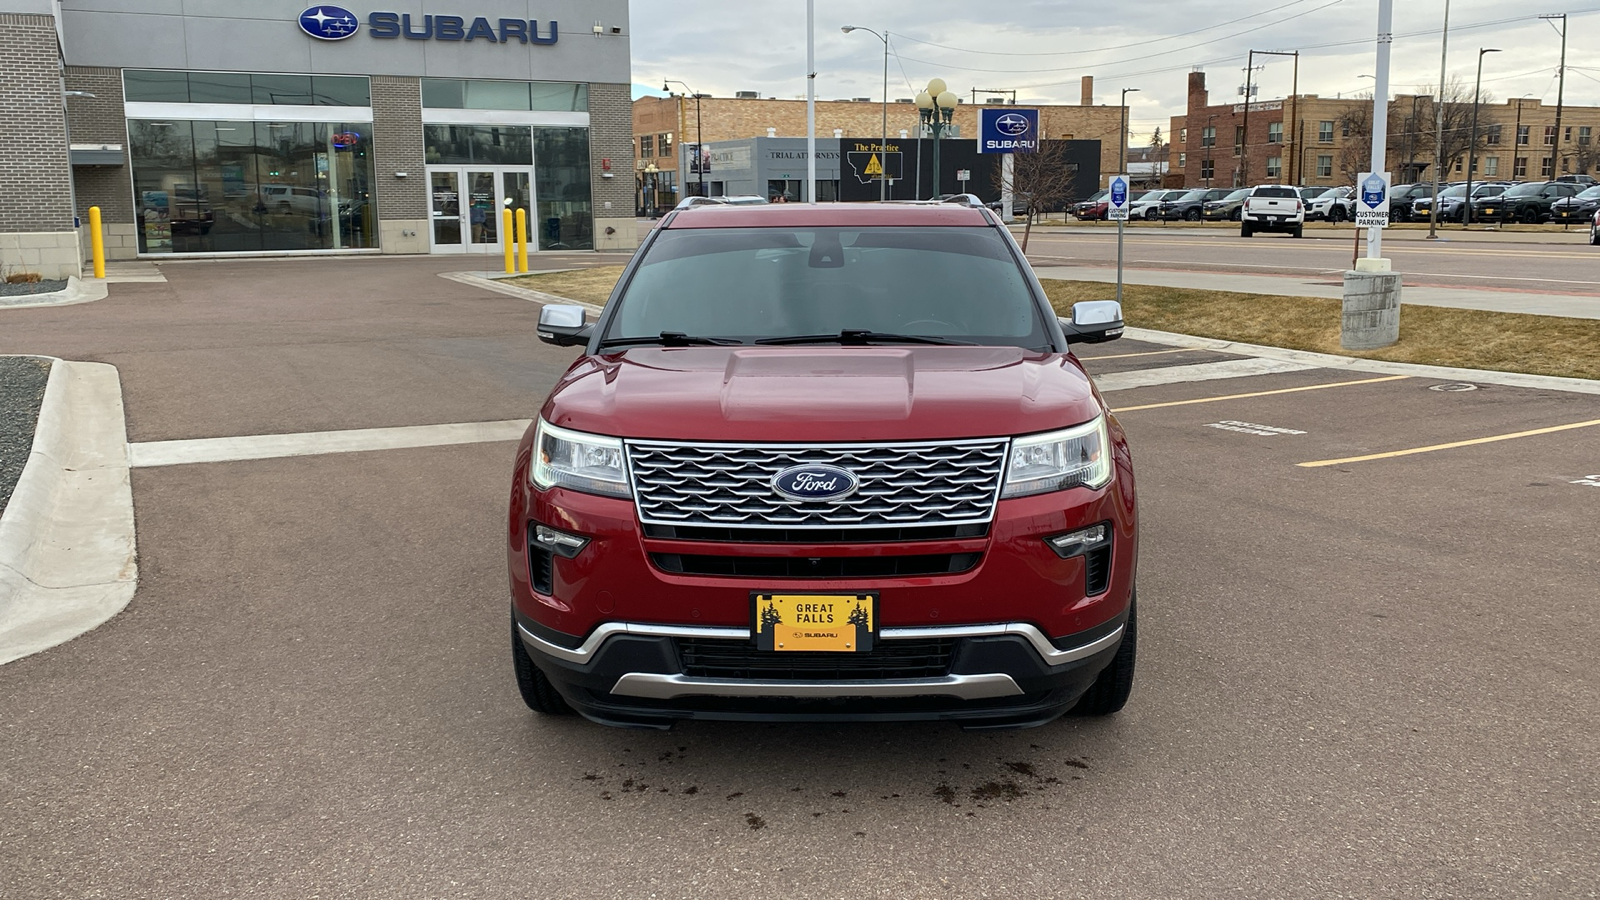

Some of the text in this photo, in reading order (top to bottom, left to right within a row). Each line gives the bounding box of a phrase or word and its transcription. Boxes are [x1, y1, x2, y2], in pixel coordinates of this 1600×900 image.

[369, 11, 559, 45] SUBARU
[854, 143, 900, 152] The Pratice
[791, 472, 838, 491] Ford
[796, 604, 834, 613] GREAT
[796, 614, 834, 623] FALLS
